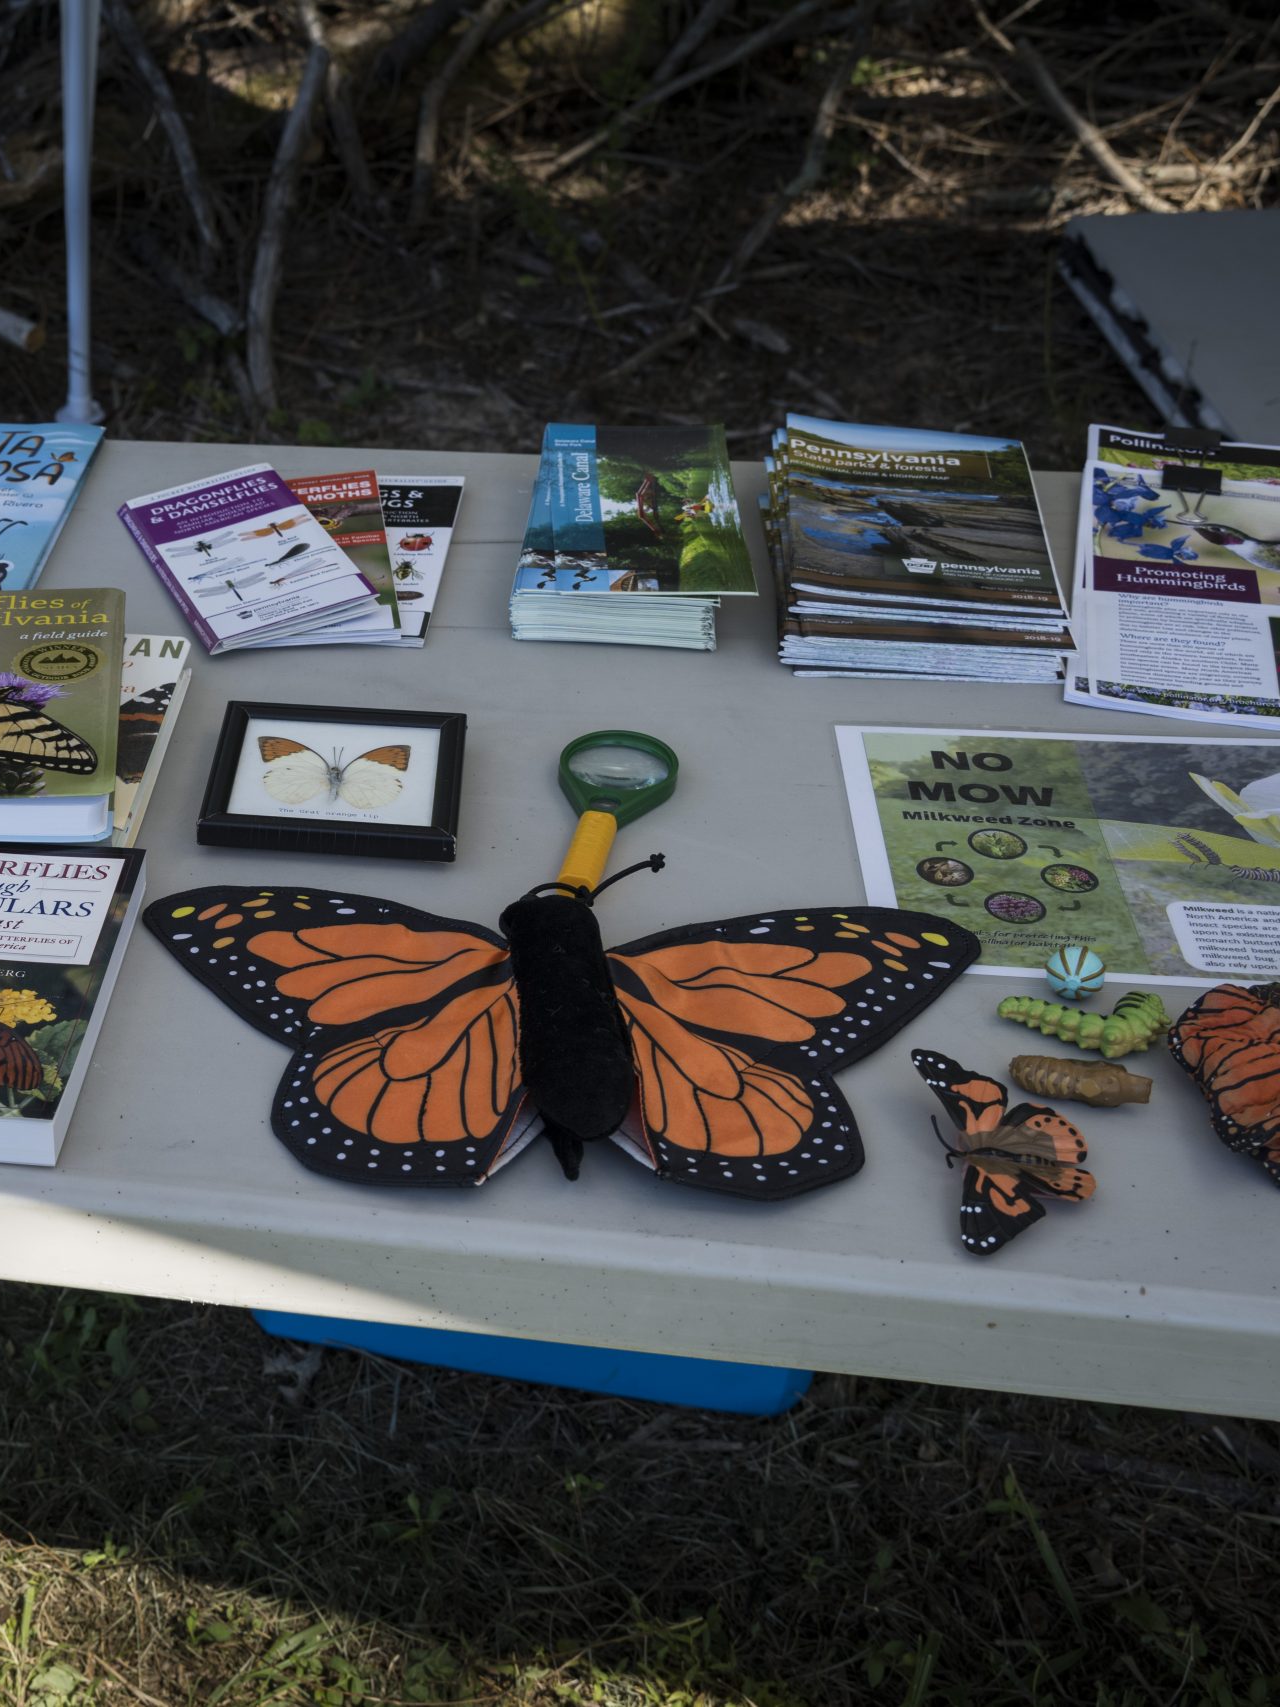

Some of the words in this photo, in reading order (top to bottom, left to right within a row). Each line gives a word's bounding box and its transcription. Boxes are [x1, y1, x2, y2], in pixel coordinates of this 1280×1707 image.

[790, 438, 961, 467] Pennsylvania
[570, 452, 590, 481] Canal
[793, 450, 832, 464] State
[836, 458, 875, 469] parks
[880, 462, 891, 470] &
[895, 463, 946, 472] forests
[150, 476, 267, 515] DRAGONFLIES
[307, 489, 373, 502] MOTHS
[408, 489, 425, 499] &
[150, 515, 164, 524] &
[170, 482, 279, 520] DAMSELFLIES
[575, 482, 594, 522] Delaware
[940, 562, 1041, 576] pennsylvania
[1134, 565, 1227, 583] Promoting
[1116, 573, 1246, 593] Hummingbirds
[70, 598, 93, 611] of
[32, 630, 64, 641] field
[68, 629, 109, 640] guide
[1120, 632, 1152, 642] Where
[1170, 636, 1192, 645] they
[1193, 638, 1226, 647] found?
[38, 644, 87, 654] WINNER
[930, 750, 1014, 773] NO
[905, 779, 1055, 807] MOW
[902, 810, 1013, 826] Milkweed
[1017, 816, 1077, 830] Zone
[1182, 905, 1234, 914] Milkweed
[1218, 915, 1259, 923] America
[1222, 923, 1259, 931] species
[58, 938, 74, 946] OF
[1195, 937, 1240, 945] monarch
[1199, 945, 1247, 953] milkweed
[1201, 953, 1251, 961] milkweed
[1228, 961, 1248, 969] rely
